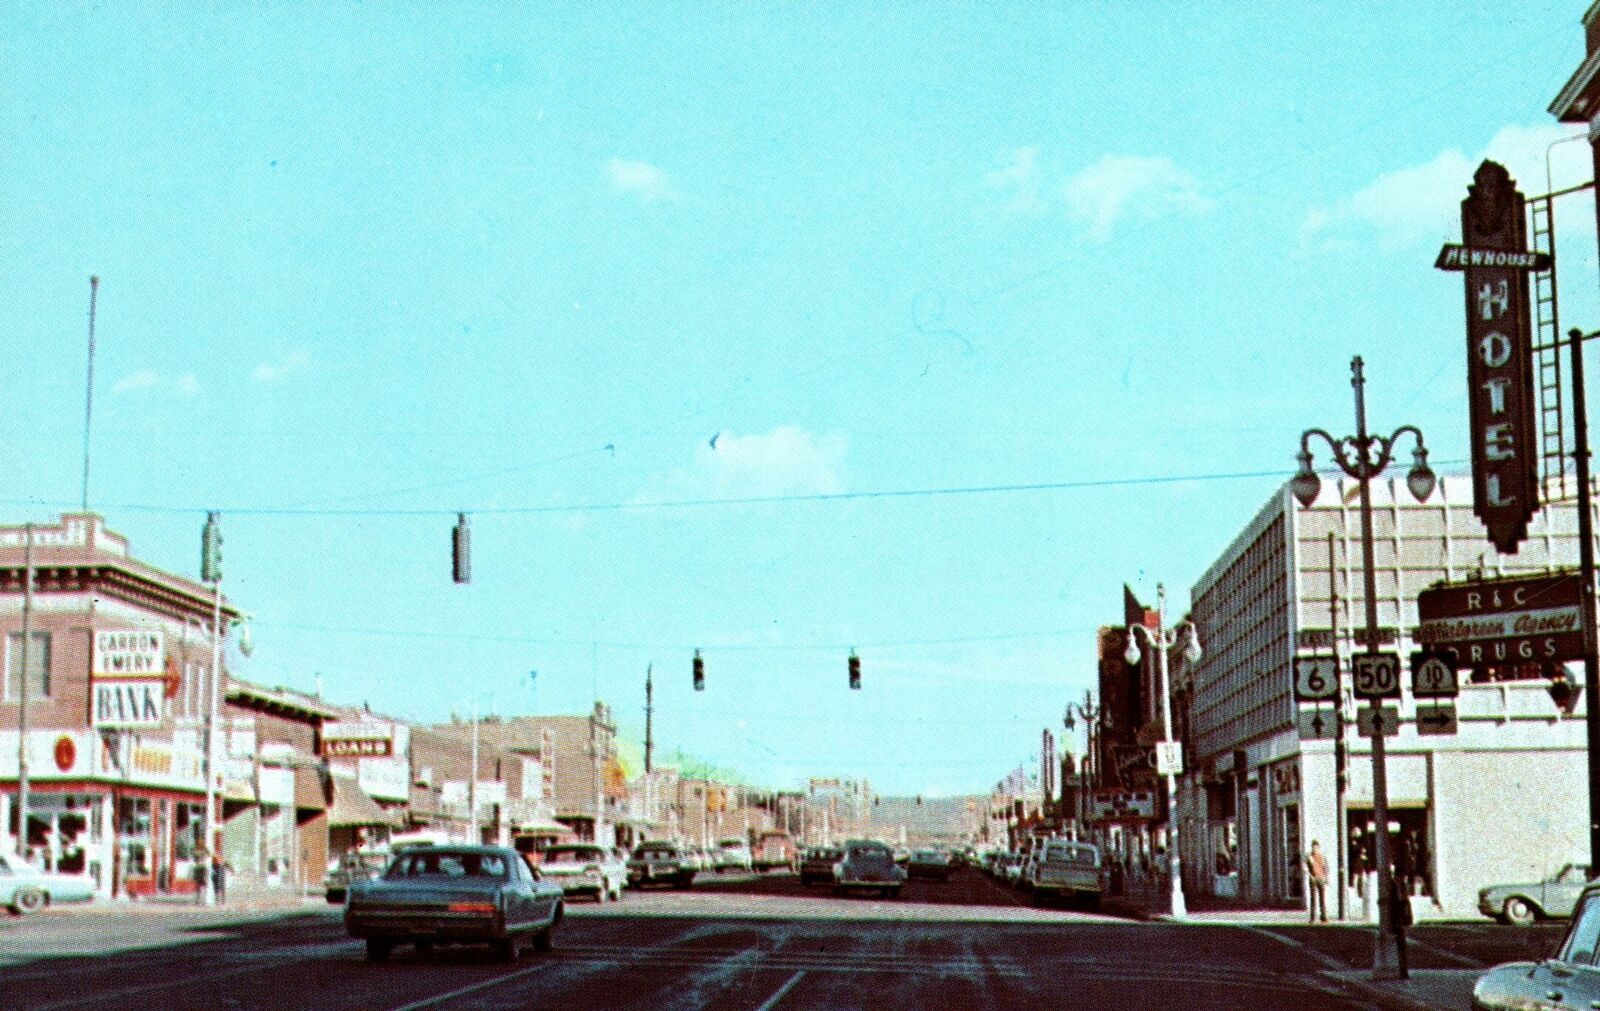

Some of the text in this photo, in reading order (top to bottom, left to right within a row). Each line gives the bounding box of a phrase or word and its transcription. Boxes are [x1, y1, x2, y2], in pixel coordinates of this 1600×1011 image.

[1444, 247, 1537, 266] NEWHOUSE
[1478, 279, 1518, 507] HOTEL
[1468, 592, 1482, 610] R
[1513, 587, 1527, 606] C
[98, 633, 159, 652] CARBON
[103, 653, 153, 671] EMERY
[1308, 667, 1325, 692] 6
[1360, 664, 1392, 689] 50
[1426, 665, 1443, 686] 10
[97, 685, 160, 721] BANK
[326, 741, 387, 755] LOANS
